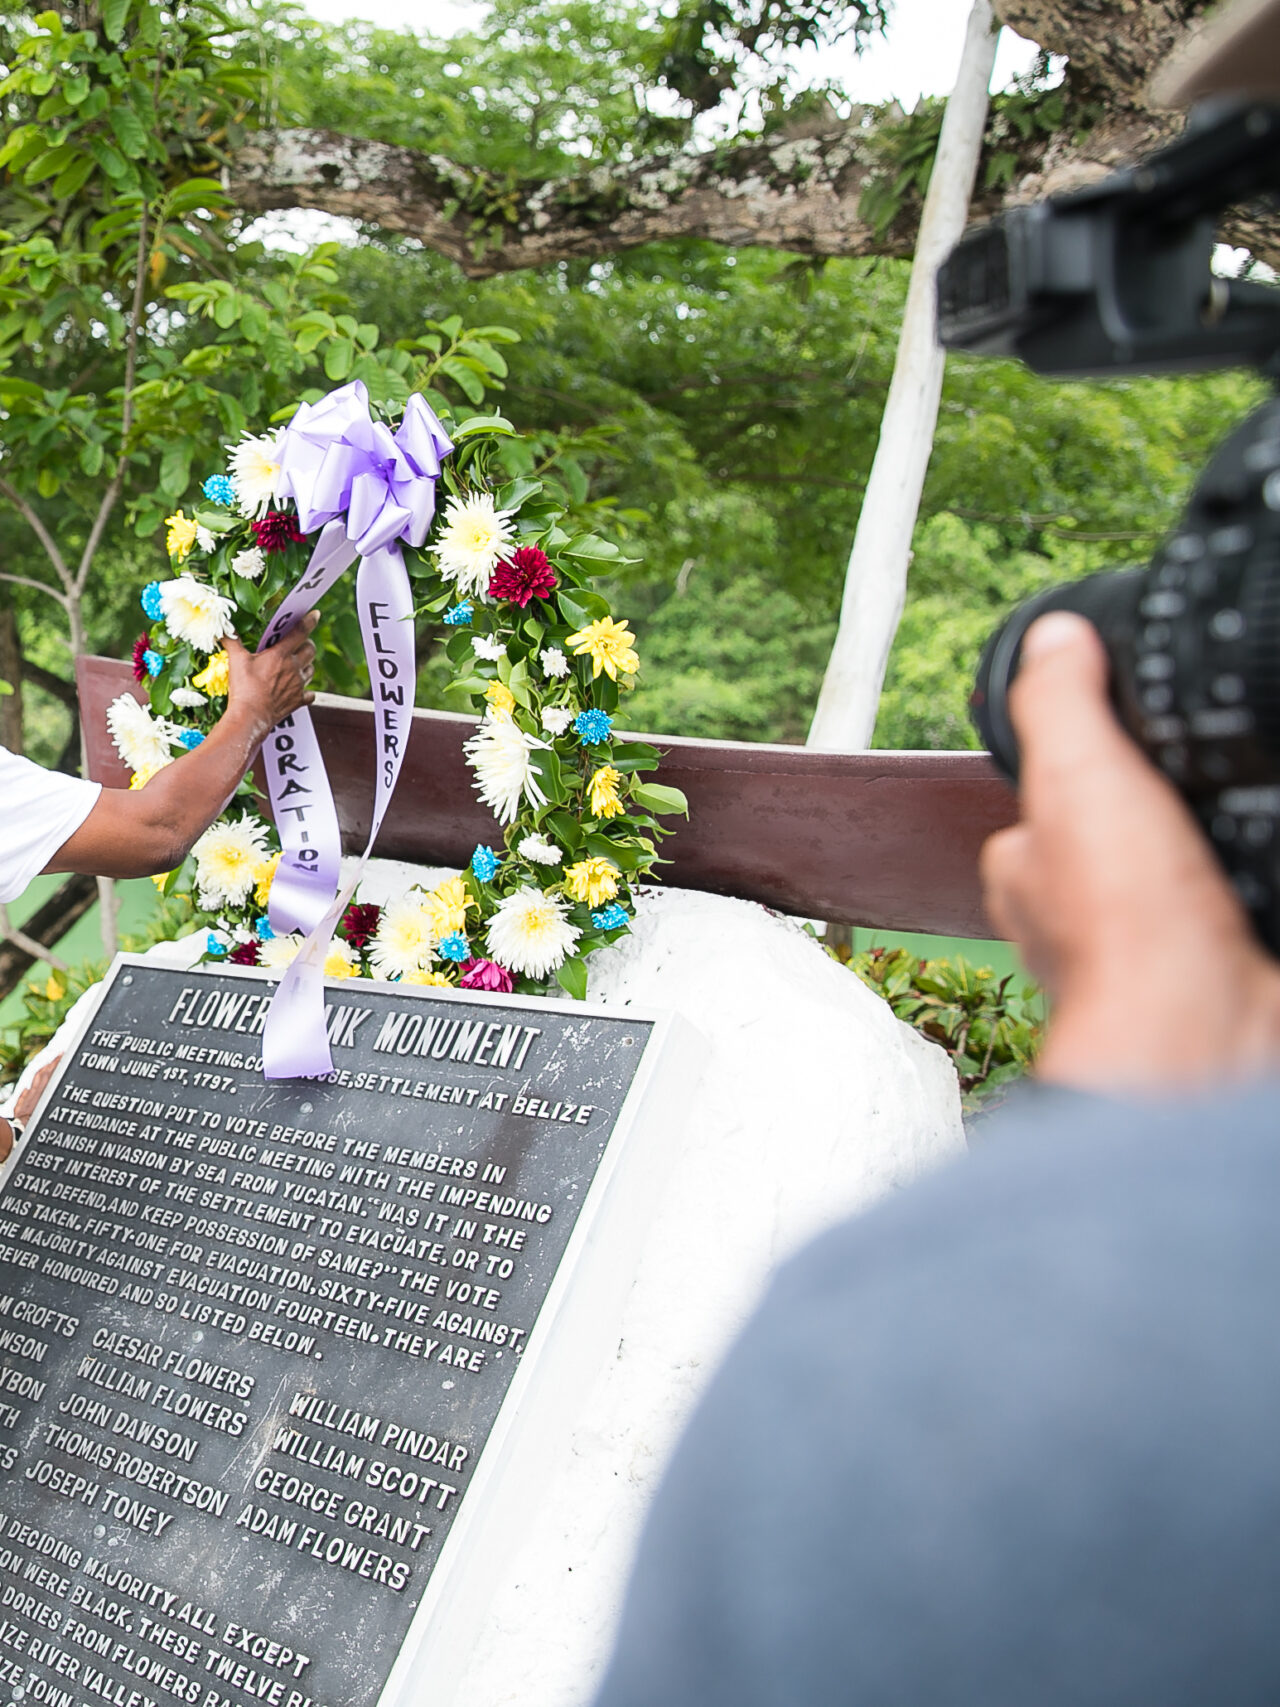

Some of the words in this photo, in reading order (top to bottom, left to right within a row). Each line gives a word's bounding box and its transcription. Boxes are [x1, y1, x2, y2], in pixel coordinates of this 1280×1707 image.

[369, 602, 404, 789] FLOWERS
[167, 987, 278, 1034] FLOWER
[373, 1011, 541, 1070] MONUMENT
[80, 1052, 119, 1072] TOWN
[121, 1060, 160, 1078] JUNE
[194, 1072, 236, 1093] 1797.
[91, 1031, 121, 1048] THE
[119, 1036, 174, 1056] PUBLIC
[478, 1092, 508, 1110] AT
[512, 1095, 595, 1124] BELIZE
[48, 1106, 138, 1137] ATTENDANCE
[139, 1125, 162, 1141] AT
[164, 1128, 197, 1149] THE
[198, 1136, 257, 1161] PUBLIC
[259, 1149, 335, 1178] MEETING
[339, 1165, 391, 1189] WITH
[397, 1176, 435, 1199] THE
[439, 1185, 552, 1223] IMPENDING
[62, 1084, 92, 1103] THE
[92, 1092, 165, 1117] QUESTION
[164, 1105, 198, 1124] PUT
[200, 1111, 221, 1128] TO
[225, 1116, 269, 1137] VOTE
[269, 1124, 338, 1151] BEFORE
[343, 1138, 380, 1160] THE
[382, 1146, 478, 1178] MEMBERS
[481, 1163, 507, 1184] IN
[1, 1196, 32, 1216] WAS
[33, 1204, 82, 1230] TAKEN.
[169, 1241, 203, 1263] FOR
[25, 1150, 64, 1171] BEST
[64, 1159, 138, 1188] INTEREST
[139, 1177, 162, 1194] OF
[165, 1182, 198, 1203] THE
[200, 1191, 315, 1231] SETTLEMENT
[319, 1218, 342, 1238] TO
[452, 1248, 479, 1271] OR
[486, 1255, 513, 1278] TO
[37, 1128, 98, 1154] SPANISH
[98, 1142, 168, 1170] INVASION
[169, 1157, 195, 1175] BY
[194, 1163, 227, 1184] SEA
[231, 1171, 279, 1194] FROM
[424, 1212, 449, 1232] IT
[450, 1219, 477, 1239] IN
[483, 1224, 526, 1250] THE
[20, 1226, 98, 1260] MAJORITY
[96, 1248, 165, 1280] AGAINST
[166, 1268, 274, 1311] EVACUATION
[437, 1344, 484, 1372] ARE
[41, 1258, 119, 1294] HONOURED
[119, 1283, 154, 1305] AND
[154, 1293, 178, 1312] SO
[180, 1300, 246, 1333] LISTED
[140, 1205, 184, 1228] KEEP
[184, 1216, 289, 1255] POSSESSION
[291, 1243, 316, 1261] OF
[399, 1268, 440, 1295] THE
[446, 1280, 500, 1309] VOTE
[12, 1301, 79, 1337] CROFTS
[77, 1356, 152, 1400] WILLIAM
[151, 1384, 247, 1435] FLOWERS
[93, 1328, 163, 1367] CAESAR
[162, 1350, 255, 1397] FLOWERS
[43, 1421, 116, 1468] THOMAS
[113, 1451, 230, 1516] ROBERTSON
[59, 1393, 113, 1427] JOHN
[112, 1412, 198, 1461] DAWSON
[269, 1426, 365, 1479] WILLIAM
[365, 1461, 456, 1509] SCOTT
[289, 1392, 381, 1441] WILLIAM
[381, 1423, 468, 1470] PINDAR
[25, 1460, 100, 1505] JOSEPH
[102, 1489, 174, 1536] TONEY
[255, 1464, 344, 1518] GEORGE
[344, 1501, 431, 1549] GRANT
[234, 1504, 298, 1545] ADAM
[297, 1527, 410, 1589] FLOWERS
[7, 1520, 82, 1568] DECIDING
[223, 1621, 310, 1677] EXCEPT
[23, 1562, 71, 1598] WERE
[69, 1585, 132, 1632] BLACK.
[138, 1617, 201, 1663] THESE
[205, 1649, 286, 1706] TWELVE
[2, 1586, 62, 1630] DORIES
[61, 1618, 112, 1657] FROM
[111, 1644, 201, 1702] FLOWERS
[27, 1638, 80, 1680] RIVER
